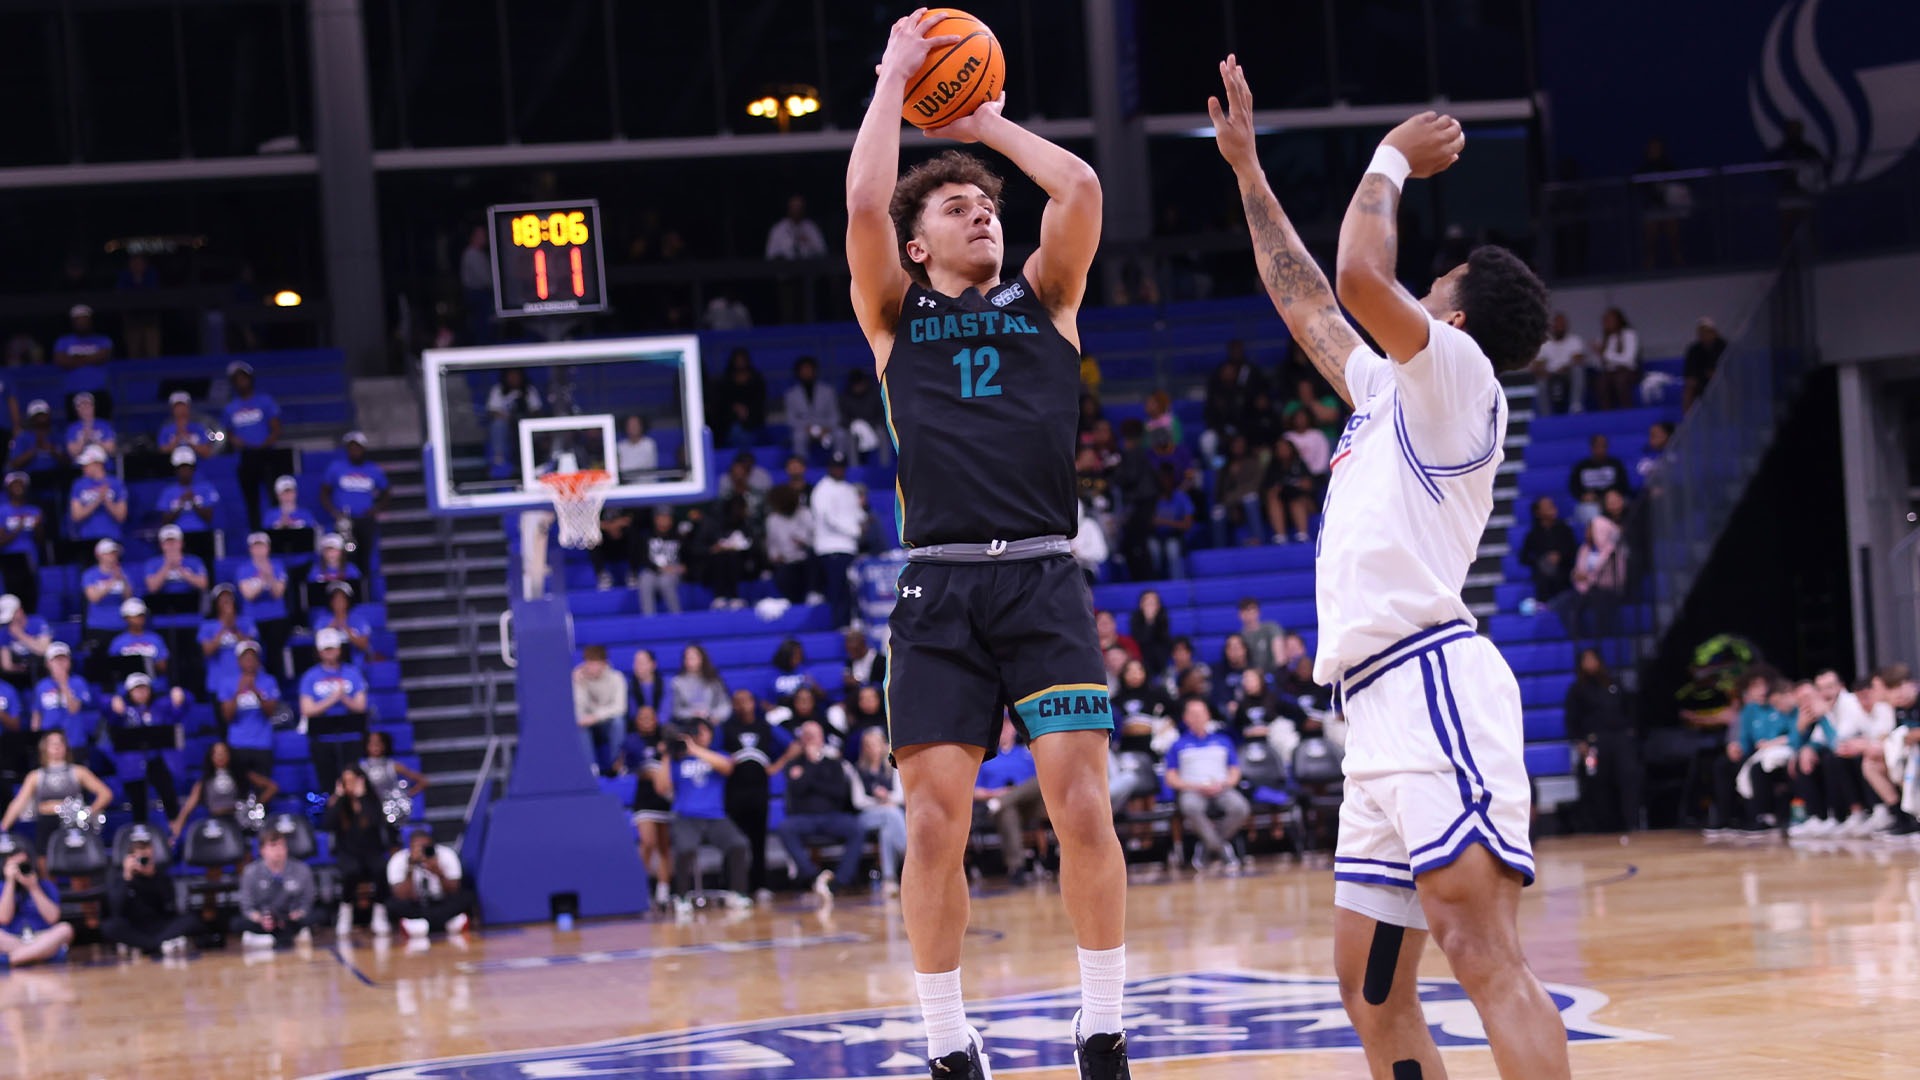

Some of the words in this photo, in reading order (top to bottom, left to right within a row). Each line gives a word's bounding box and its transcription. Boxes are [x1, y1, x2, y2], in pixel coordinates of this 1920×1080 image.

[913, 56, 982, 118] Wilson
[512, 211, 589, 248] 18:06
[534, 246, 585, 300] 11
[991, 282, 1025, 308] SBC
[910, 311, 1039, 343] COASTAL
[953, 346, 1003, 398] 12
[1038, 696, 1109, 718] CHAN
